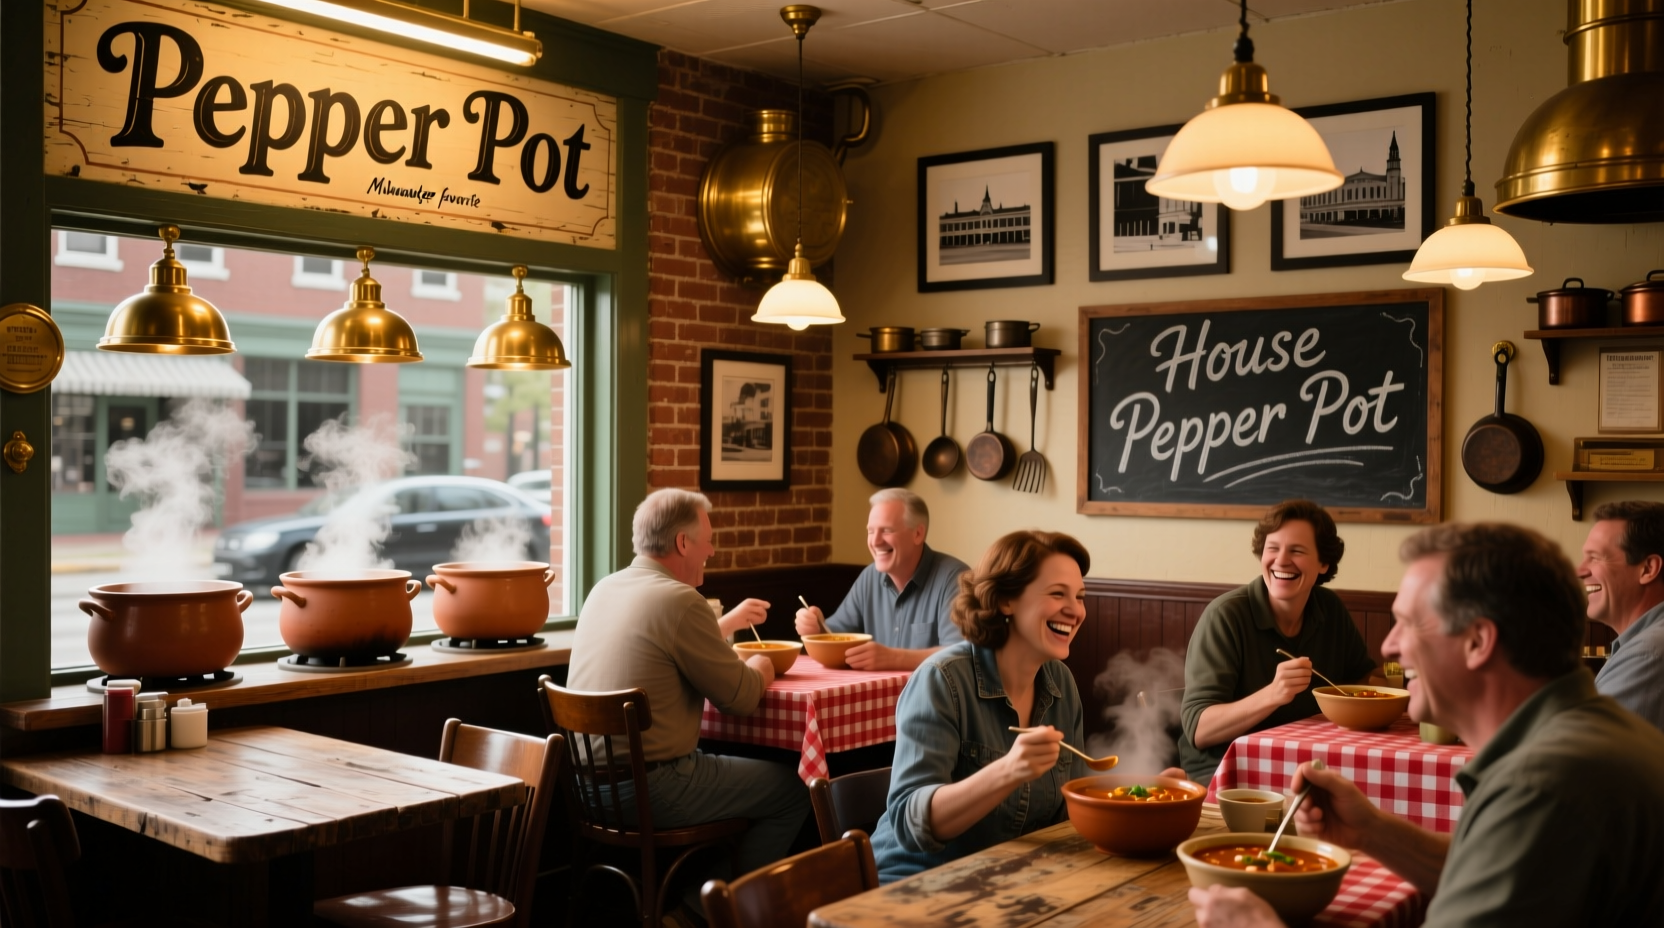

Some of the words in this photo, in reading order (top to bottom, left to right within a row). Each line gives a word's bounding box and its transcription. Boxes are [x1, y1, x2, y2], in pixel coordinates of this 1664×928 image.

[97, 21, 450, 184] Pepper
[463, 90, 592, 200] Pot
[1150, 319, 1327, 393] House
[1109, 391, 1287, 483] Pepper
[1299, 370, 1405, 445] Pot
